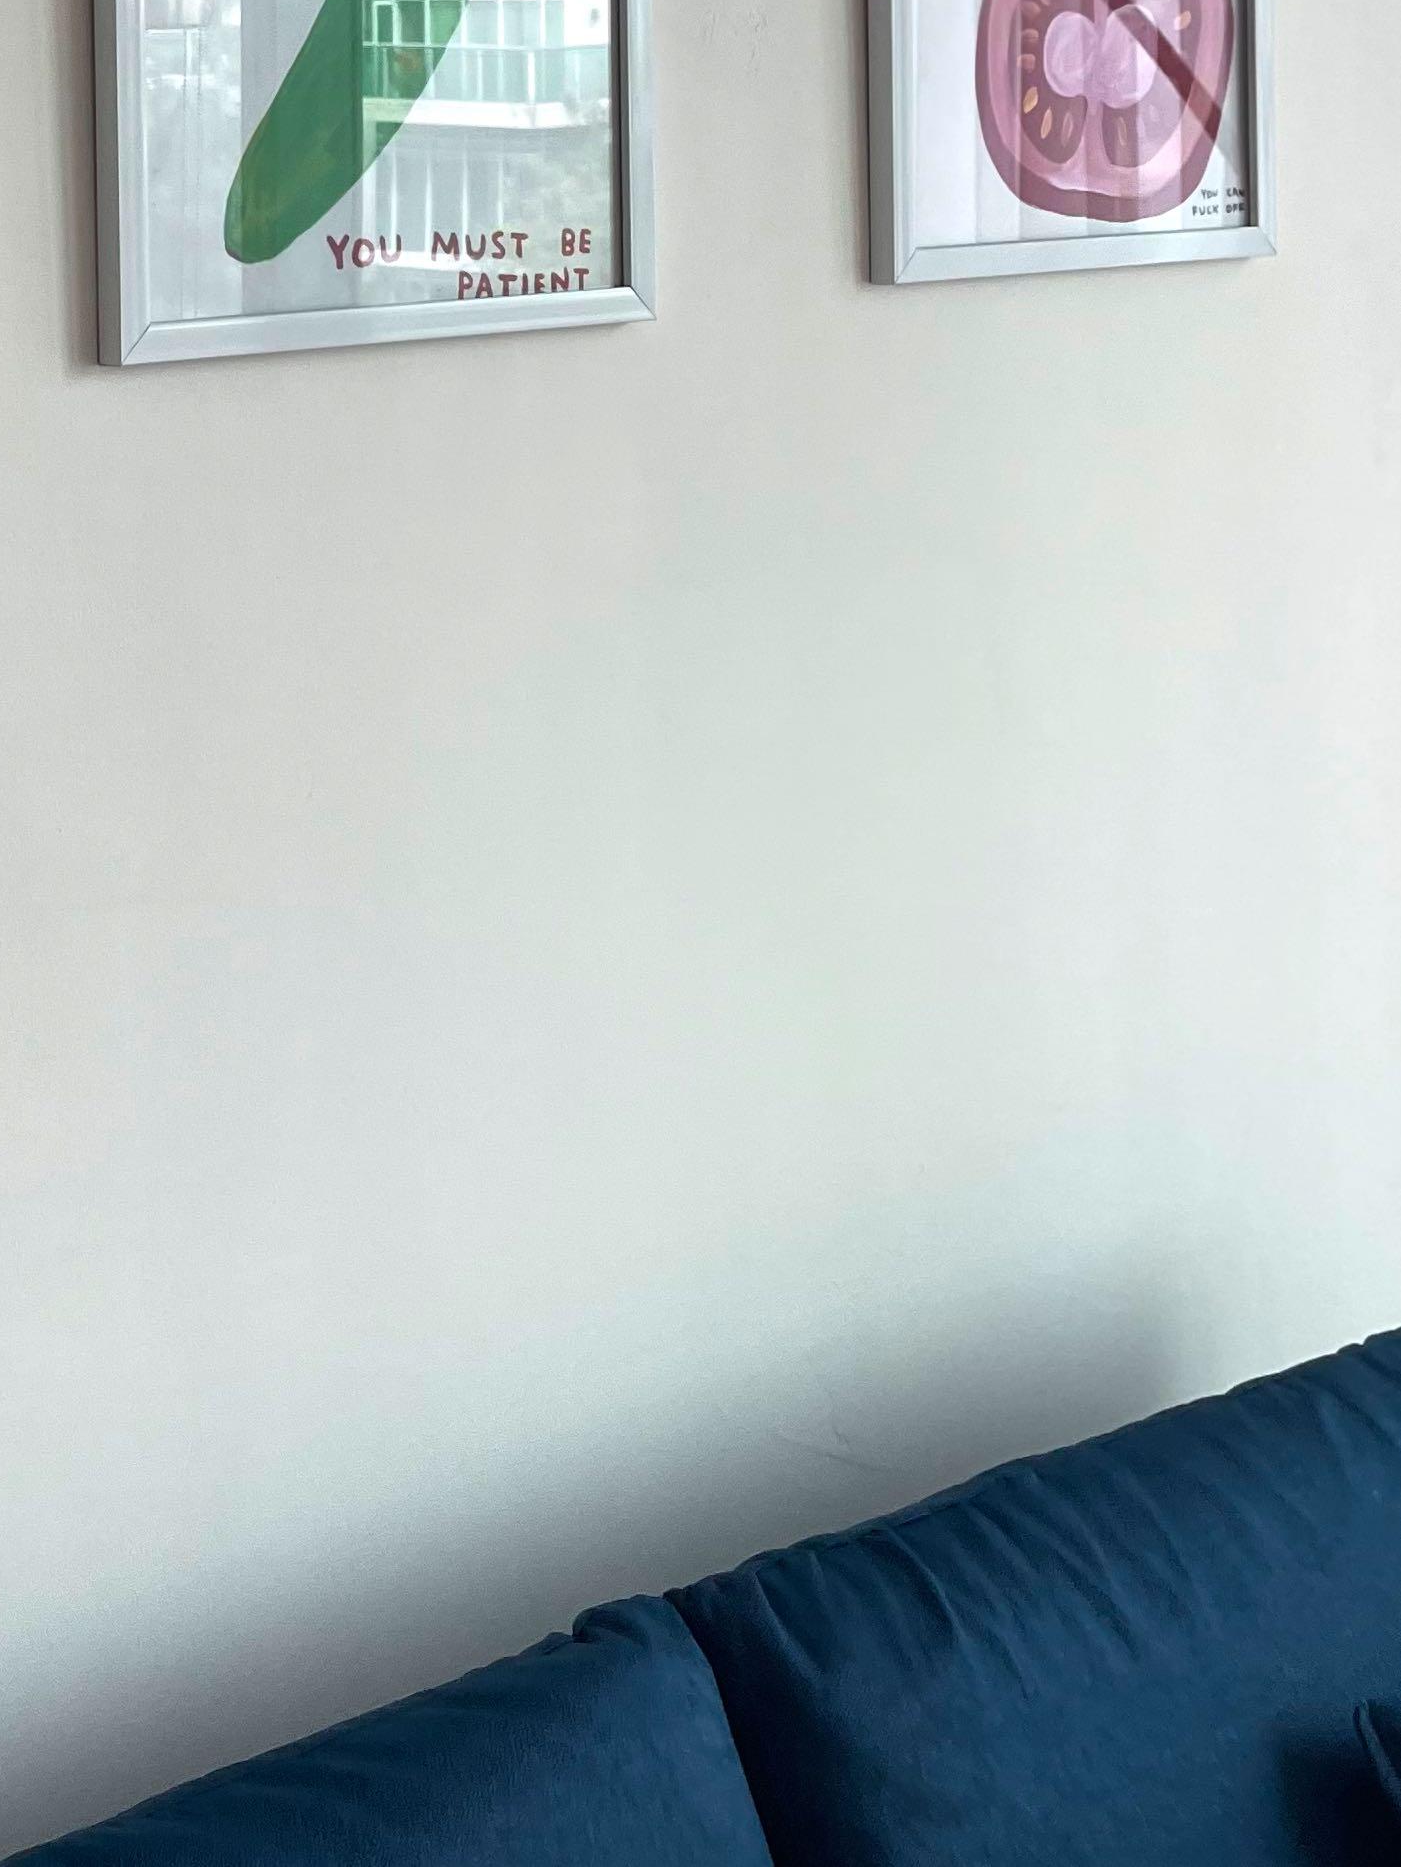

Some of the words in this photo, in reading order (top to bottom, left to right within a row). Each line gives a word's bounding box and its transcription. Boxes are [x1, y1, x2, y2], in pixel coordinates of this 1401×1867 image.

[1192, 205, 1218, 216] FUCK
[326, 233, 402, 270] YOU
[431, 230, 529, 262] MUST
[561, 227, 592, 257] BE
[458, 267, 590, 300] PATIENT
